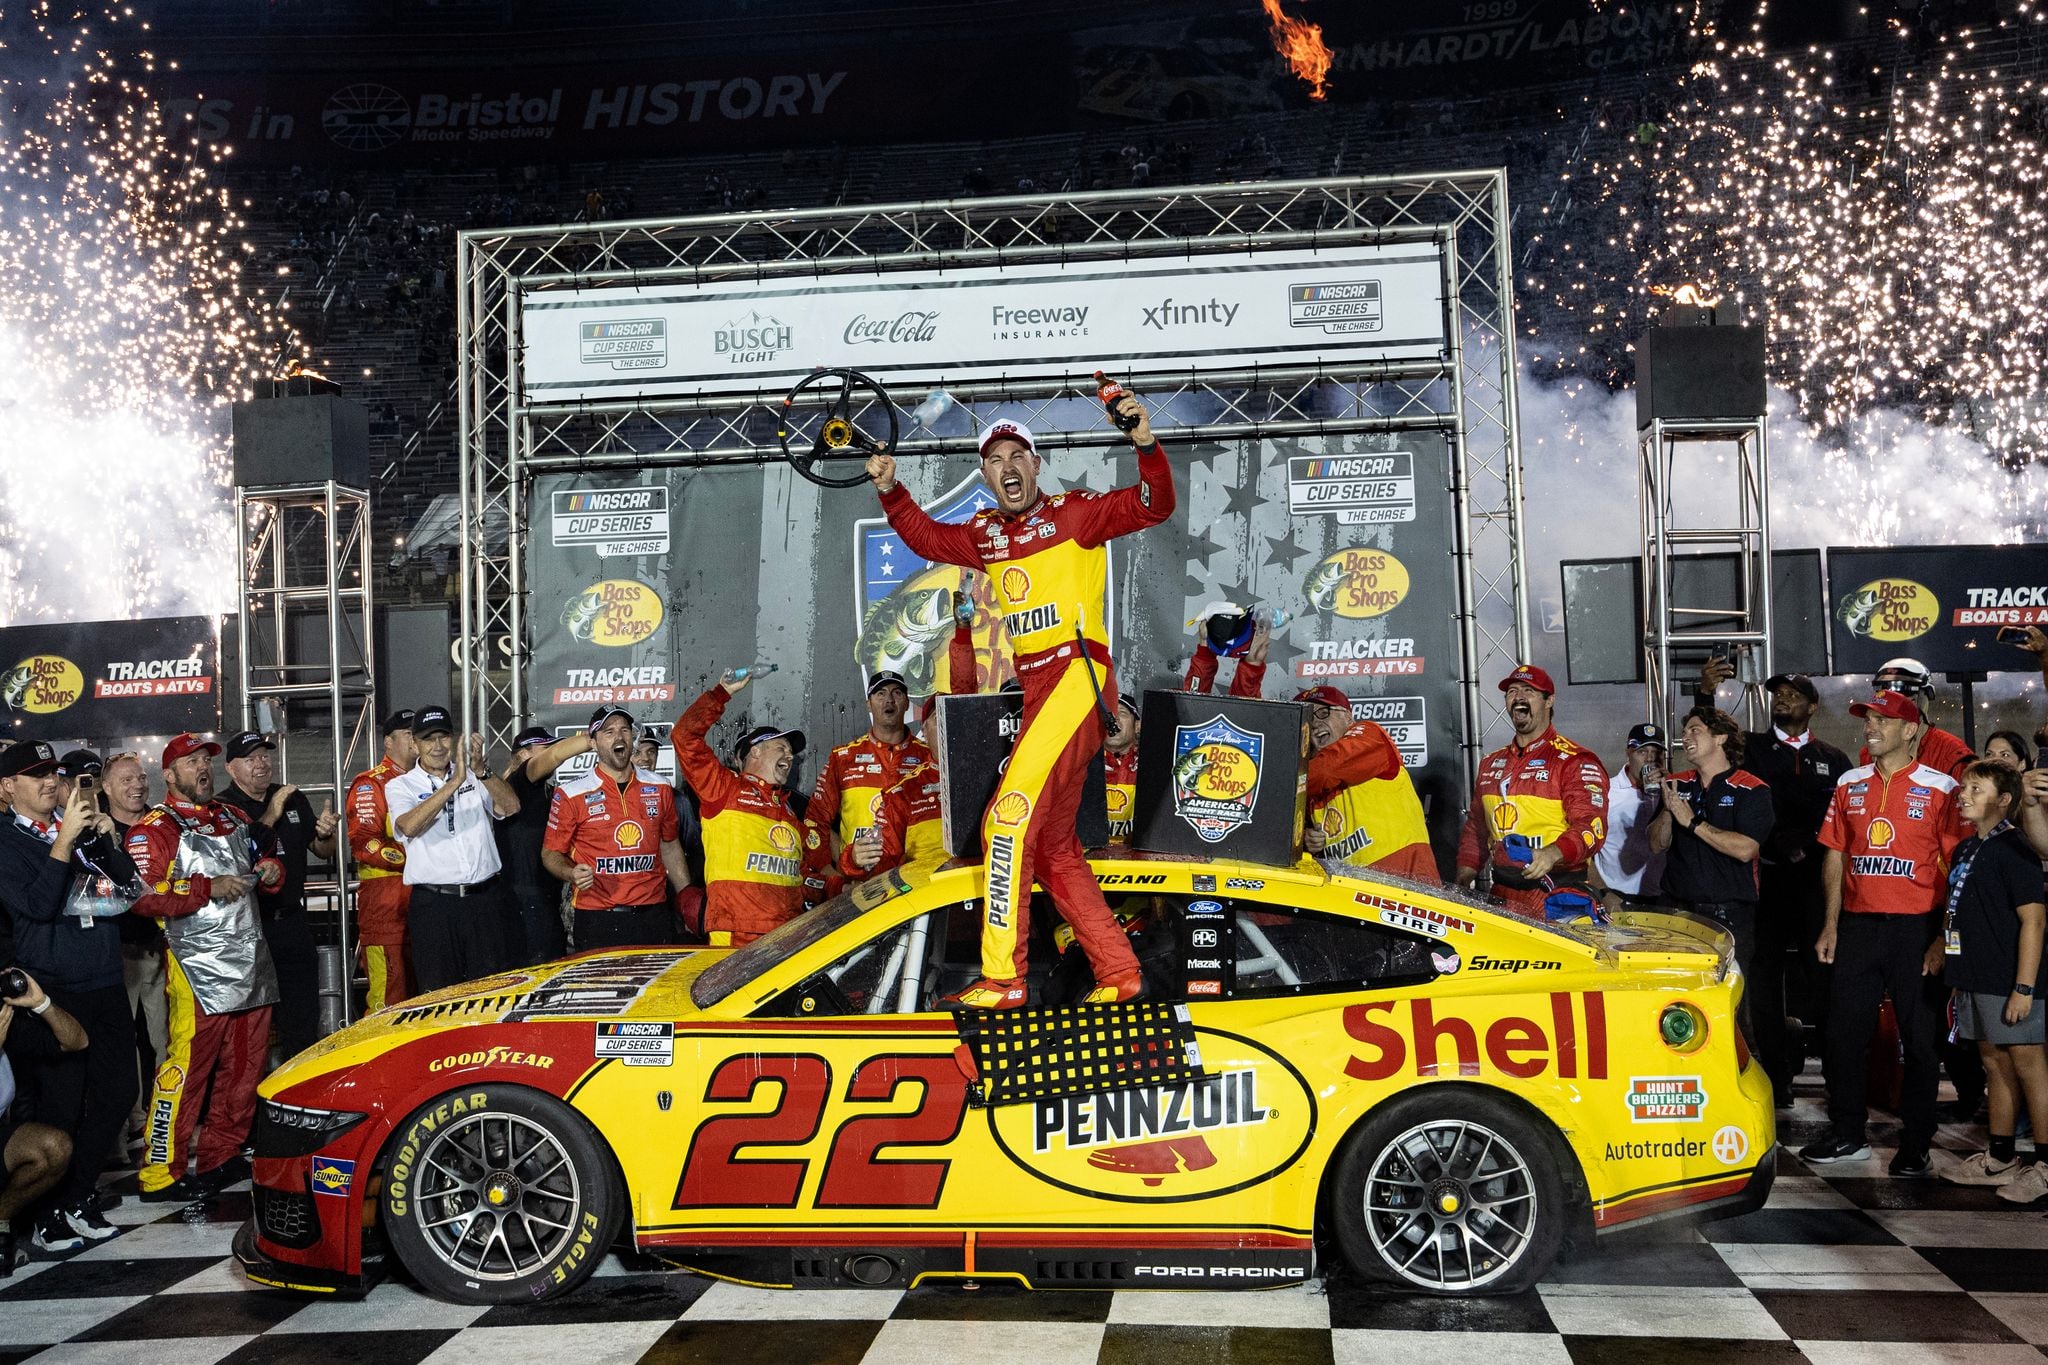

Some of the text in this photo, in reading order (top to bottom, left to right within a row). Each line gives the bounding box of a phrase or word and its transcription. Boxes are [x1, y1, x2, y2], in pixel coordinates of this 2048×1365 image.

[1462, 0, 1517, 22] 1999
[415, 89, 562, 127] Bristol
[582, 72, 848, 130] HISTORY
[247, 107, 294, 140] in
[412, 125, 554, 141] Motor Speedway
[1318, 284, 1366, 298] NASCAR
[992, 305, 1089, 327] Freeway
[1142, 297, 1240, 330] xfinity
[1303, 302, 1368, 317] CUP SERIES
[607, 323, 653, 336] NASCAR
[993, 328, 1089, 341] INSURANCE
[1332, 320, 1375, 332] THE CHASE
[593, 339, 654, 353] CUP SERIES
[714, 326, 793, 354] BUSCH
[619, 358, 660, 367] THE CHASE
[731, 351, 776, 363] LIGHT
[1329, 458, 1394, 475] NASCAR
[1307, 482, 1396, 501] CUP SERIES
[589, 493, 651, 510] NASCAR
[1347, 509, 1406, 521] THE CHASE
[568, 516, 653, 534] CUP SERIES
[606, 541, 661, 554] THE CHASE
[1345, 552, 1385, 571] Bass
[1347, 571, 1377, 590] Pro
[603, 583, 640, 603] Bass
[1879, 582, 1917, 600] Bass
[1967, 586, 2048, 608] TRACK
[1346, 589, 1398, 611] Shops
[1880, 599, 1910, 615] Pro
[604, 601, 633, 618] Pro
[1960, 610, 2020, 624] BOATS
[2024, 612, 2033, 622] &
[604, 617, 652, 640] Shops
[1004, 604, 1061, 637] NNZOIL
[1881, 614, 1929, 635] Shops
[1309, 639, 1414, 660] TRACKER
[33, 658, 65, 674] Bass
[107, 659, 203, 681] TRACKER
[1302, 661, 1416, 676] BOATS & ATVs
[36, 673, 59, 689] Pro
[566, 667, 666, 688] TRACKER
[101, 682, 152, 696] BOATS
[165, 680, 205, 694] ATVs
[559, 688, 668, 703] BOATS & ATVs
[34, 688, 75, 707] Shops
[1351, 703, 1406, 720] ASCAR
[1208, 747, 1240, 764] Bass
[1208, 762, 1232, 777] Pro
[1206, 775, 1247, 796] Shops
[1186, 807, 1242, 817] NIGHT RACE
[1187, 799, 1243, 811] AMERICA'S
[1323, 827, 1372, 860] NNZOIL
[596, 855, 656, 875] PENNZOIL
[988, 833, 1014, 929] PENNZOIL
[1095, 875, 1167, 884] OGANO
[1194, 903, 1216, 911] Ford
[1354, 891, 1475, 934] DISCOUNT
[1387, 912, 1439, 934] TIRE
[1194, 931, 1215, 945] PPG
[1187, 959, 1221, 969] Mazak
[1468, 955, 1561, 973] Snap-on
[1008, 989, 1022, 1000] 22
[620, 1024, 661, 1036] NASCAR
[1343, 991, 1607, 1080] Shell
[606, 1039, 662, 1050] CUP SERIES
[429, 1046, 554, 1073] GOODYEAR
[646, 1056, 667, 1064] CHASE
[1646, 1083, 1684, 1093] HUNT
[1632, 1094, 1700, 1104] BROTHERS
[1036, 1070, 1267, 1152] PENNZOIL
[1646, 1105, 1686, 1115] PIZZA
[150, 1098, 172, 1165] PENNZOIL
[670, 1052, 968, 1210] 22
[390, 1092, 488, 1217] GOODYEAR
[1605, 1137, 1706, 1161] Autotrader
[314, 1171, 350, 1183] SUNOCO
[551, 1211, 599, 1285] EAGLE
[1134, 1266, 1304, 1277] FORD RACING
